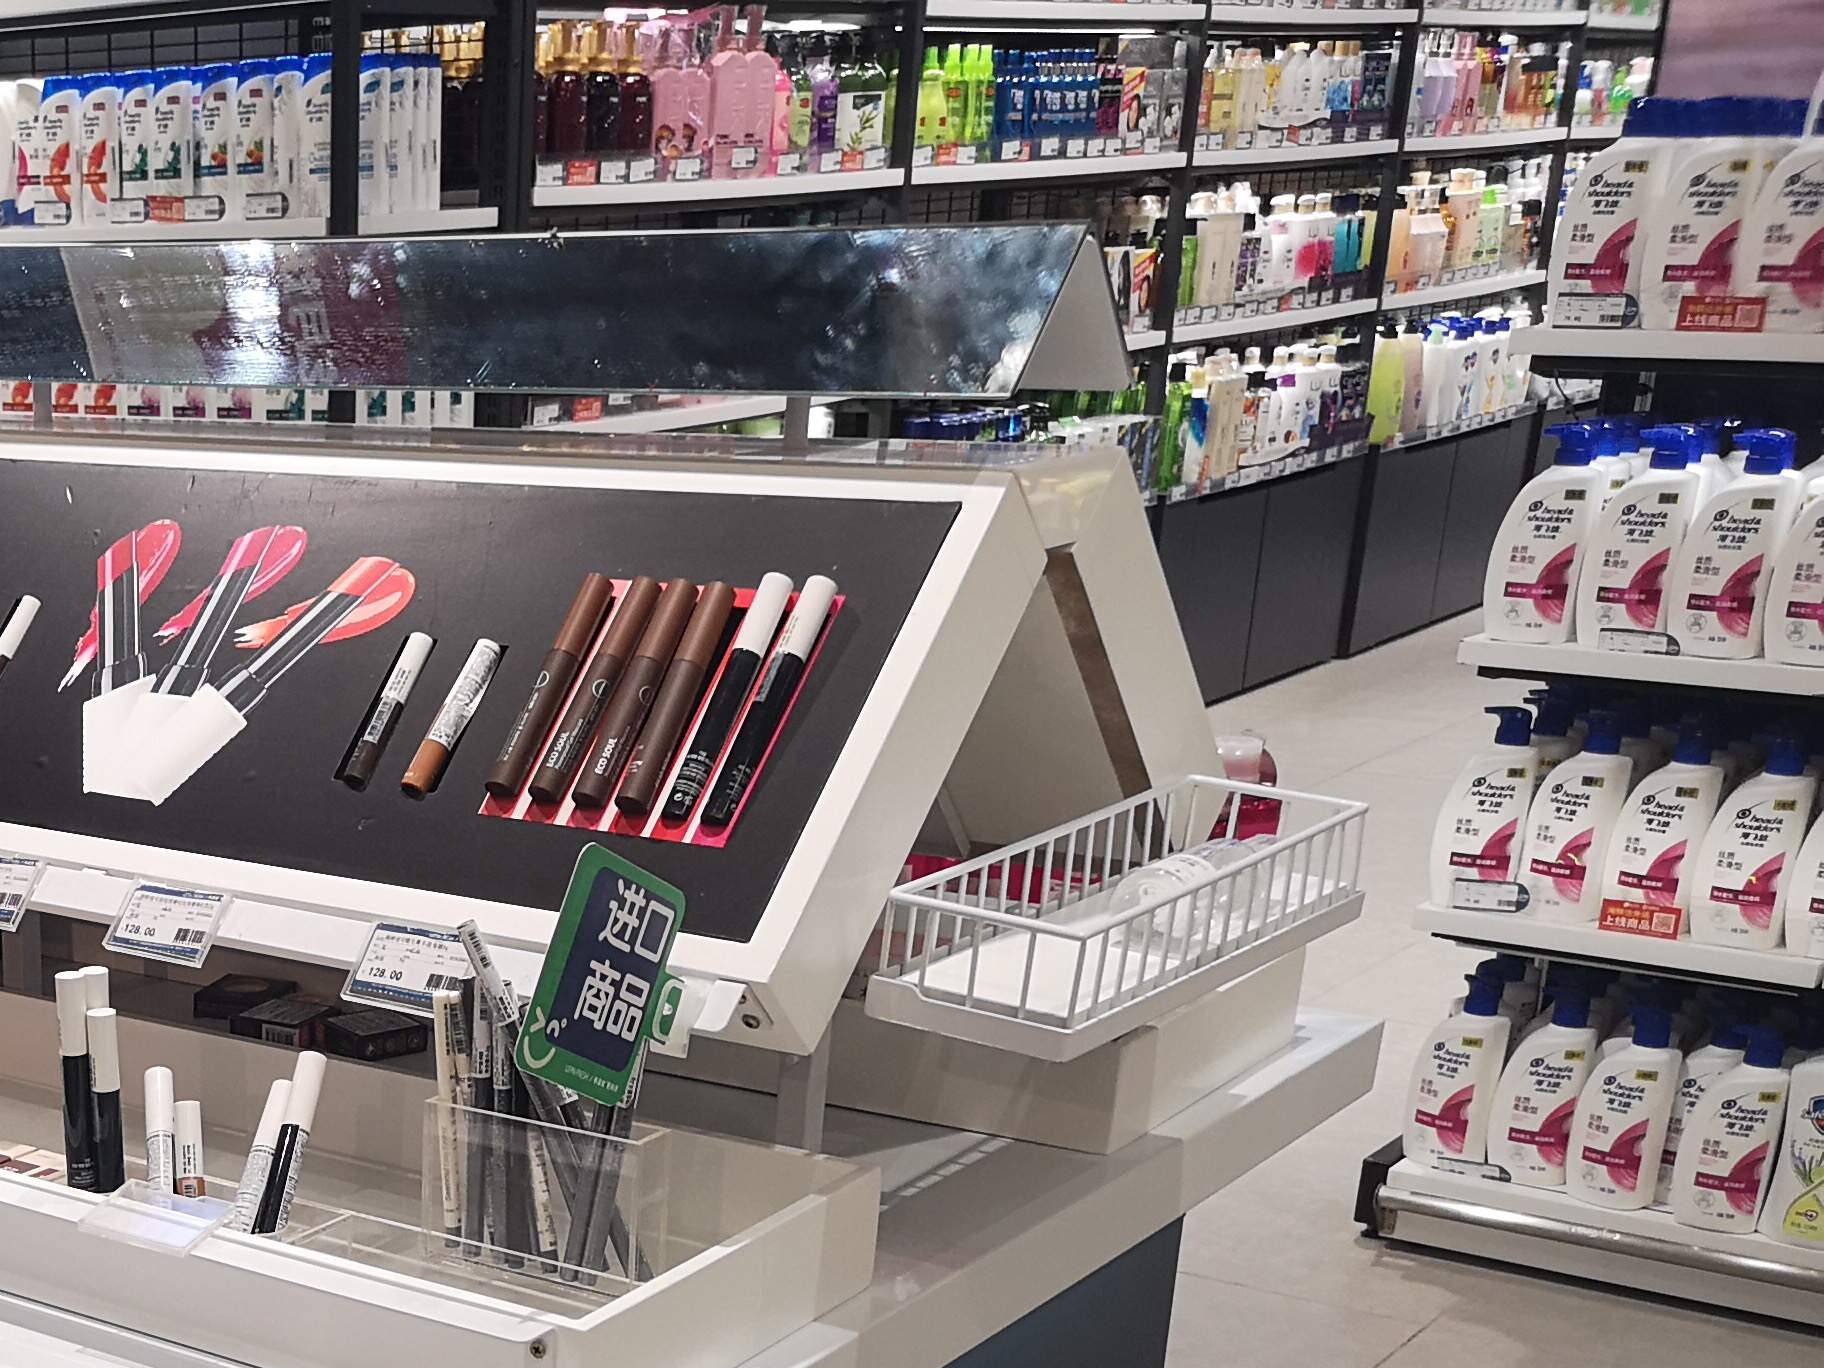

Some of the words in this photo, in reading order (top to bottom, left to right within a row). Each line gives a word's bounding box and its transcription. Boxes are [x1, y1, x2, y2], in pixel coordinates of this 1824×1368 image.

[1527, 514, 1573, 524] shoulders
[1620, 518, 1666, 529] shoulders
[1727, 516, 1762, 526] head&
[1712, 523, 1761, 535] shoulders
[597, 876, 676, 964] 进口
[124, 923, 156, 938] 128.00
[368, 966, 403, 982] 128.00
[573, 958, 651, 1043] 商品
